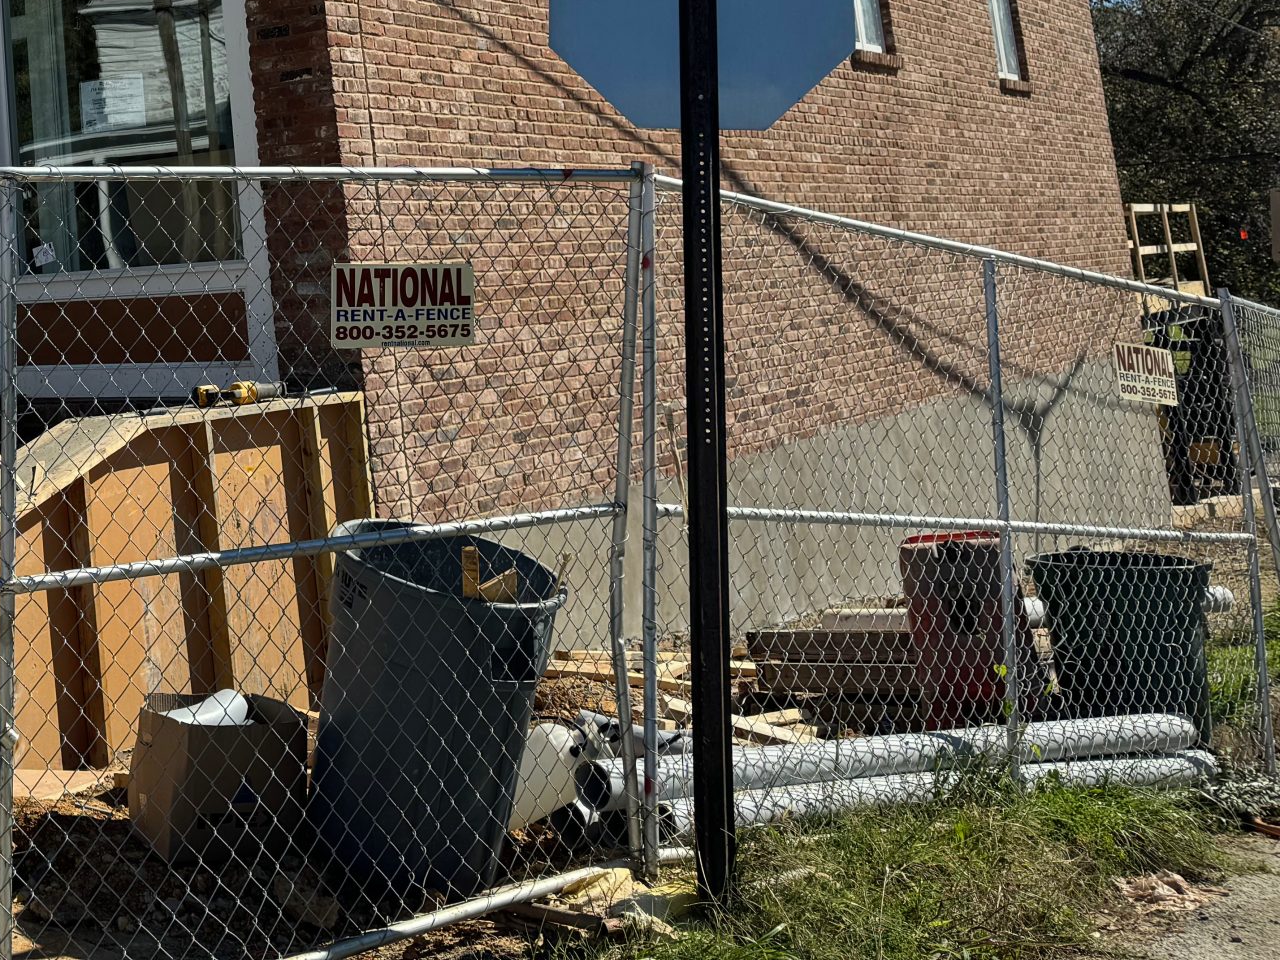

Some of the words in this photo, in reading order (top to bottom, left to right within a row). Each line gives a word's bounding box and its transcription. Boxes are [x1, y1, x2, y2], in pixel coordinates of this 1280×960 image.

[336, 267, 471, 308] NATIONAL
[336, 307, 472, 322] RENT-A-FENCE
[335, 324, 471, 340] 800-352-5675
[1115, 344, 1173, 378] NATIONAL
[1119, 372, 1175, 389] RENT-A-FENCE
[1120, 384, 1176, 401] 800-352-5675
